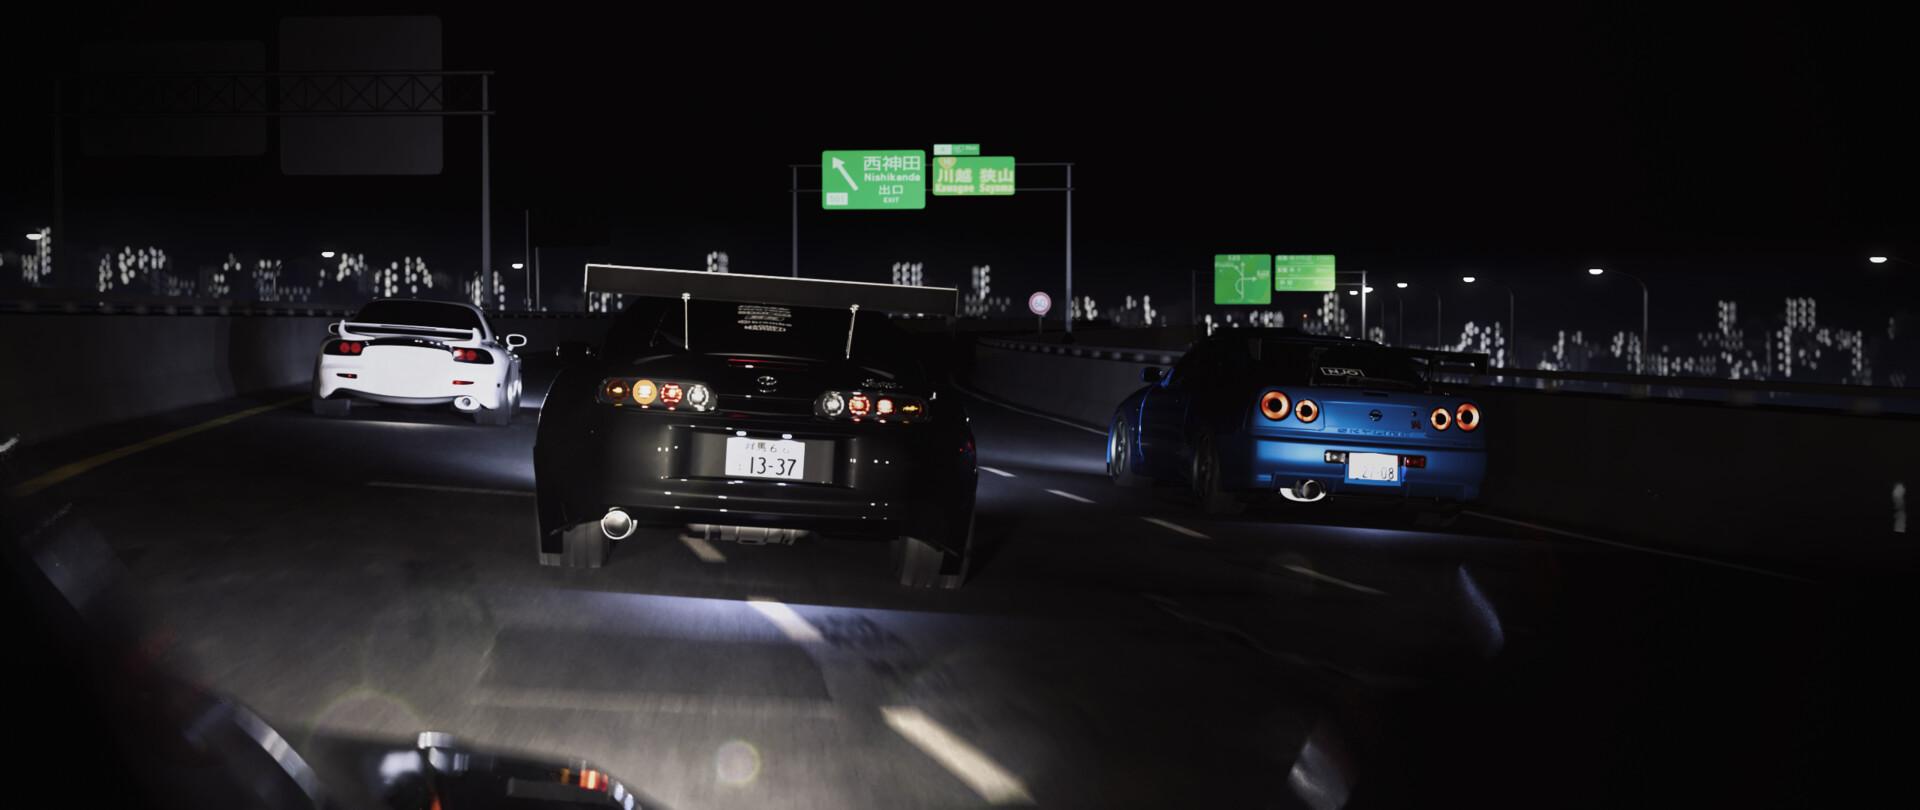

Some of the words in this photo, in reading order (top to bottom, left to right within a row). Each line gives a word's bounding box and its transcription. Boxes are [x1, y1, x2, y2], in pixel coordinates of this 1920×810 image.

[863, 155, 921, 171] 西神田
[864, 173, 921, 182] Nishikanda
[938, 168, 973, 183] 川越
[878, 185, 904, 195] 出口
[750, 456, 798, 476] 13-37
